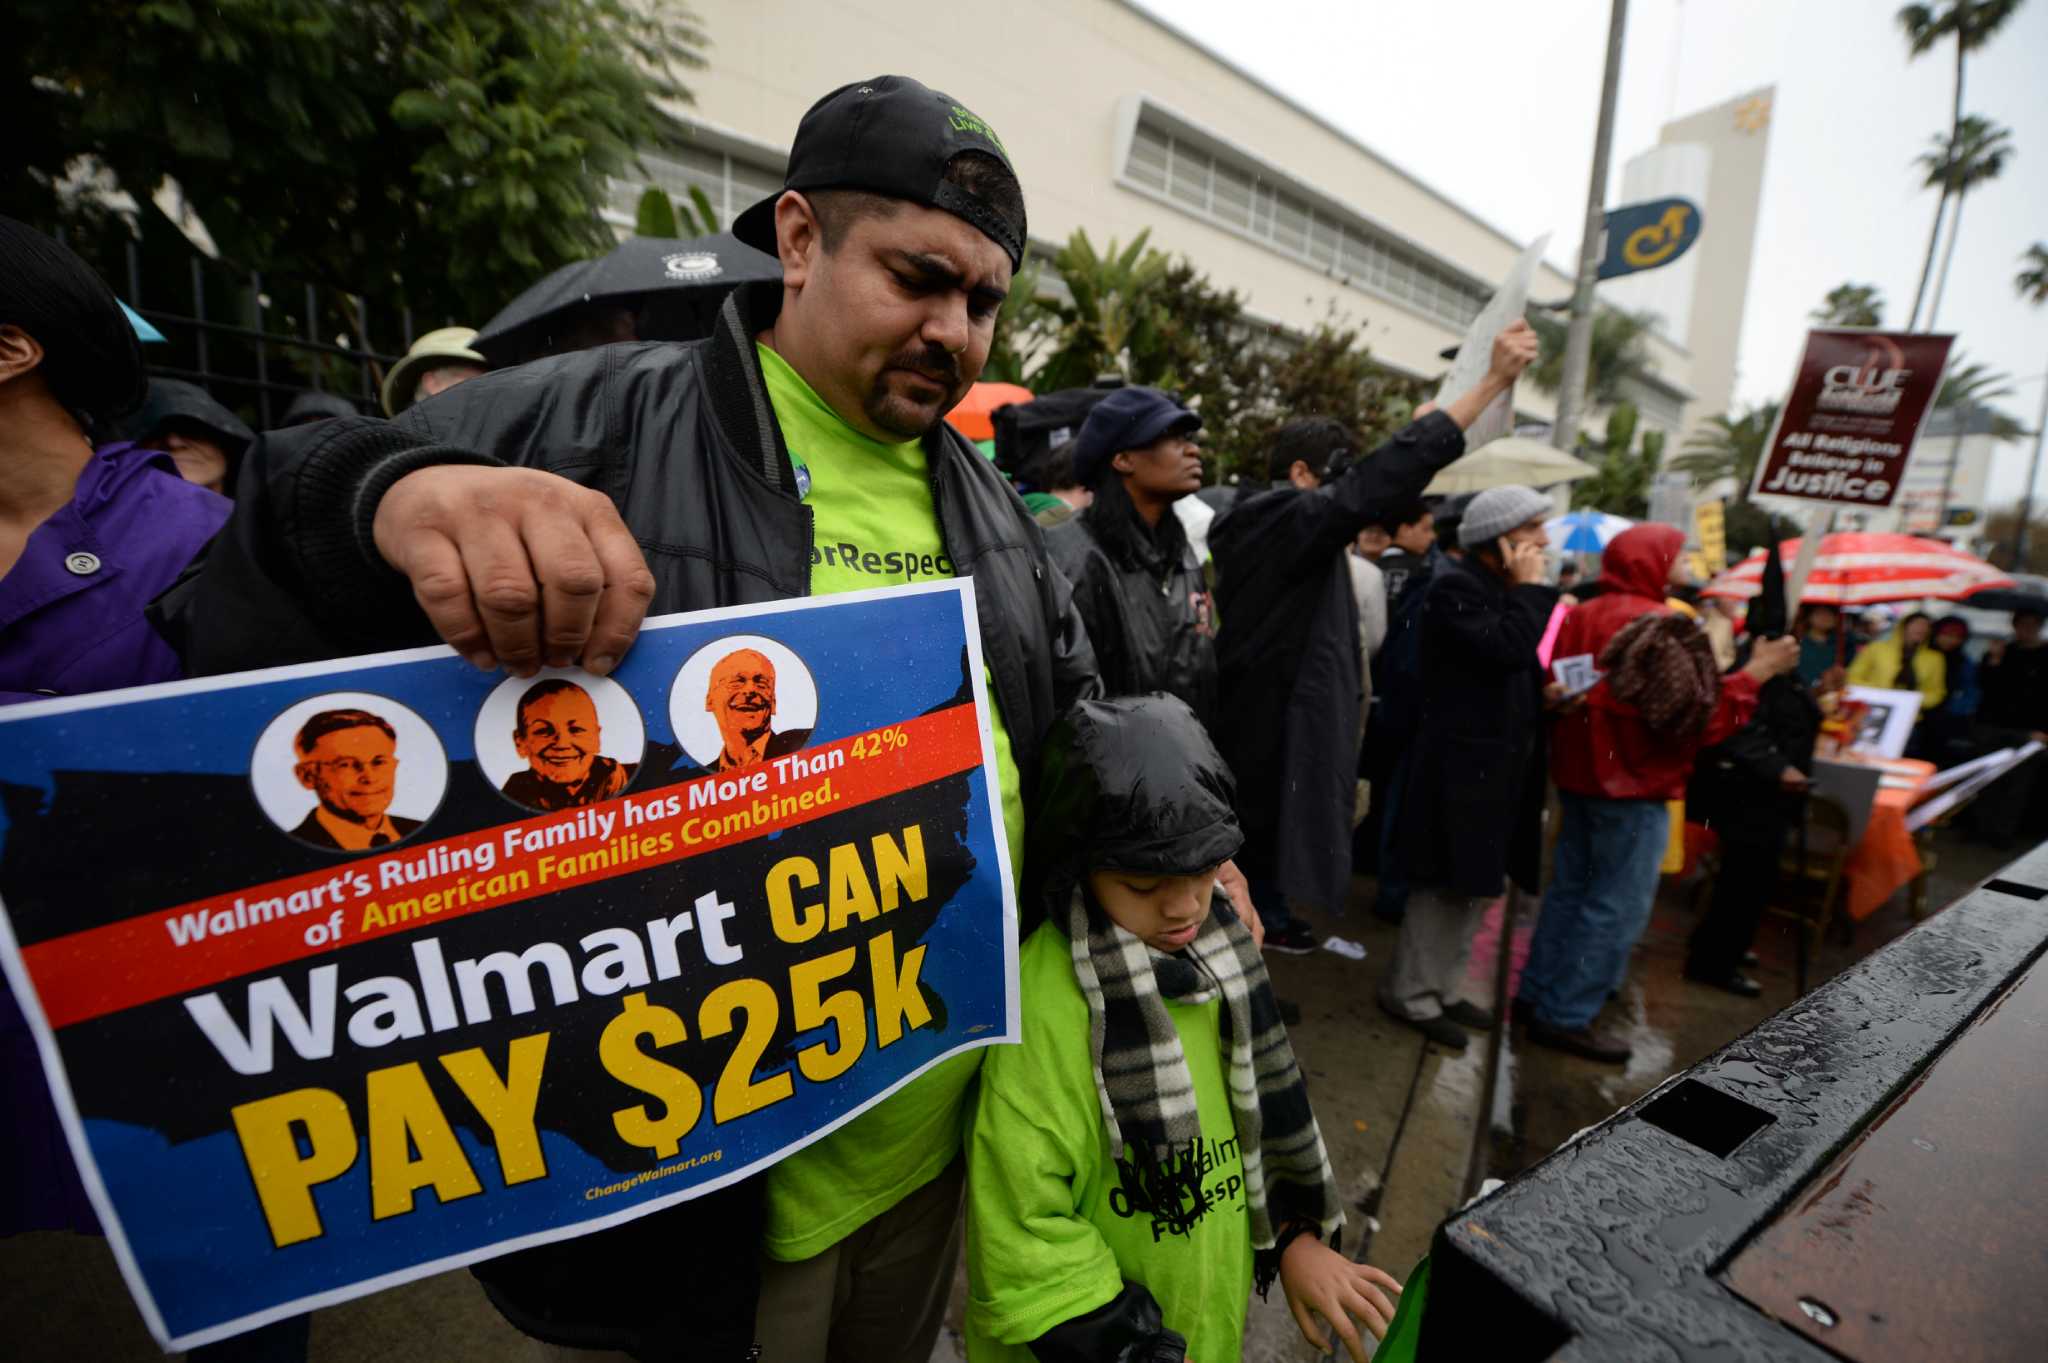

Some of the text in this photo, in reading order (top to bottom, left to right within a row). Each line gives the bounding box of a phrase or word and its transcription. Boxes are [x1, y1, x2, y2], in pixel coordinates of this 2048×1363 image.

[1782, 432, 1903, 457] All Religions
[1787, 450, 1886, 474] Believe in
[1766, 466, 1891, 500] Justice
[811, 542, 955, 582] orRespec
[165, 726, 909, 947] Walmart's Ruling Family has More Than 42%
[304, 778, 841, 946] of American Families Combined.
[183, 824, 930, 1076] Walmart CAN
[231, 929, 933, 1248] PAY $25k
[584, 1149, 723, 1201] ChangeWalmart.org
